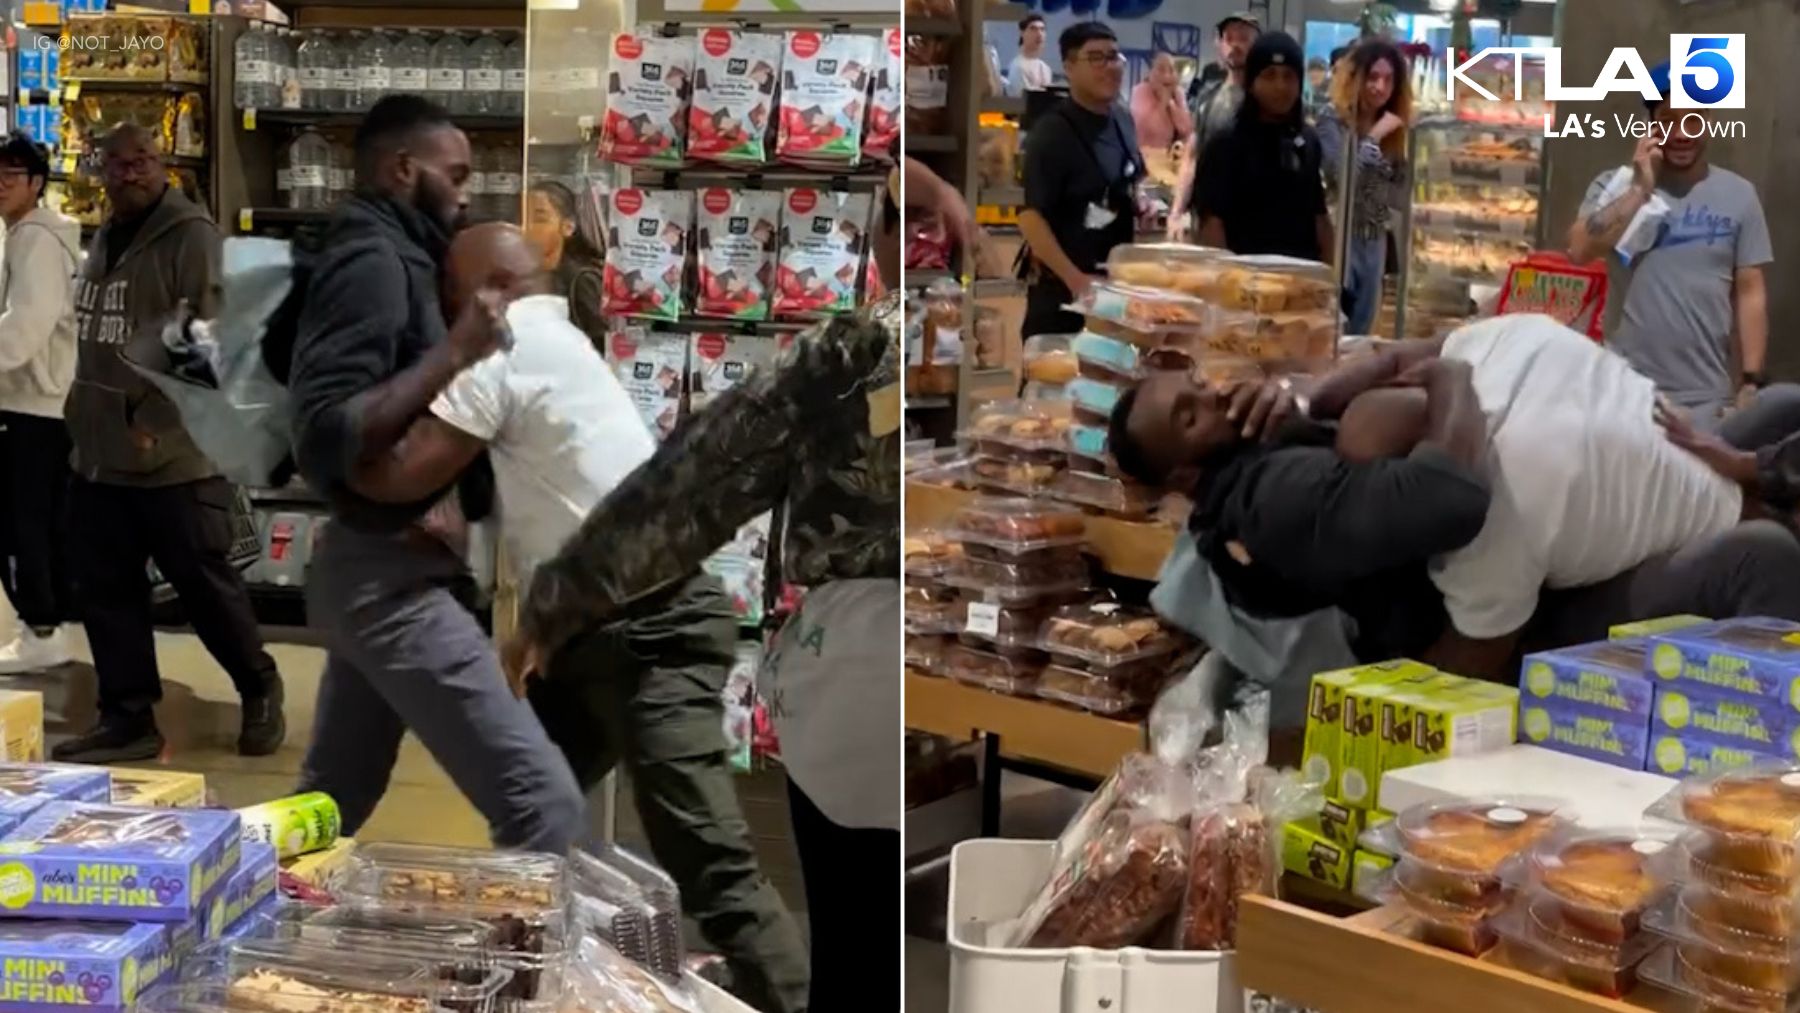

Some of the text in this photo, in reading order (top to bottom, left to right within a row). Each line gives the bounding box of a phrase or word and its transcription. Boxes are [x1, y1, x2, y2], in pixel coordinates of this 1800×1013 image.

[77, 864, 138, 885] MINI
[4, 958, 66, 979] MINI
[0, 980, 93, 1005] UFFIN
